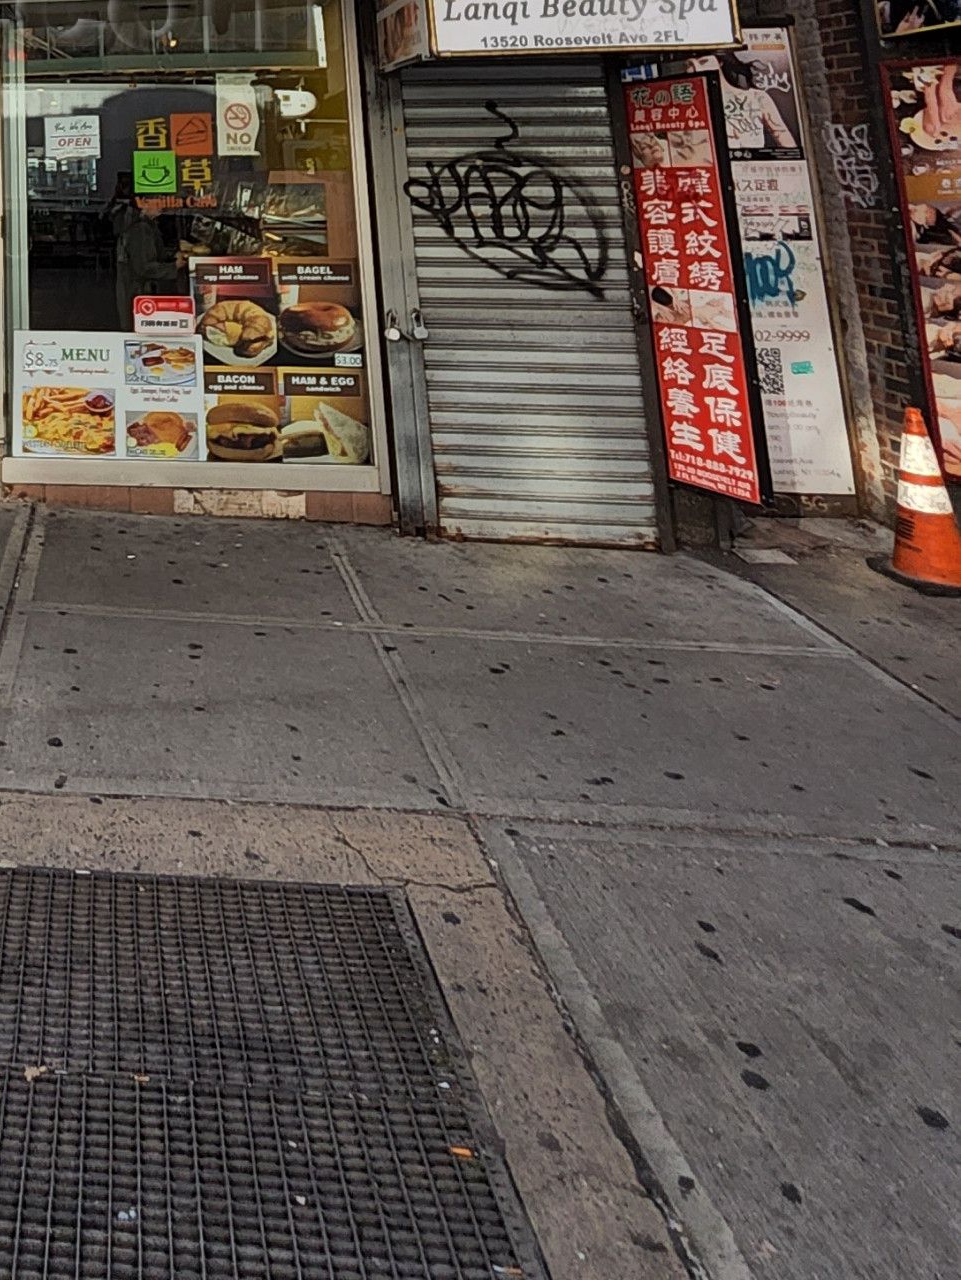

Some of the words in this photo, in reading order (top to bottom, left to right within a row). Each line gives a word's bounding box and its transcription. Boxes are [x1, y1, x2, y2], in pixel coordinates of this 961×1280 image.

[480, 34, 529, 49] 13520
[534, 31, 614, 47] Roosevelt
[618, 31, 648, 45] Ave
[653, 29, 685, 43] 2FL
[136, 118, 167, 148] 香
[225, 132, 252, 145] NO
[57, 137, 92, 147] OPEN
[181, 158, 212, 191] 草
[219, 265, 244, 275] HAM
[296, 266, 334, 275] BAGEL
[25, 350, 59, 369] $8.75
[61, 348, 111, 362] MENU
[217, 375, 256, 384] BACON
[291, 376, 317, 386] HAM
[318, 376, 329, 386] &
[331, 377, 355, 386] EGG
[658, 326, 705, 452] 經絡養生
[698, 331, 747, 465] 足底保健
